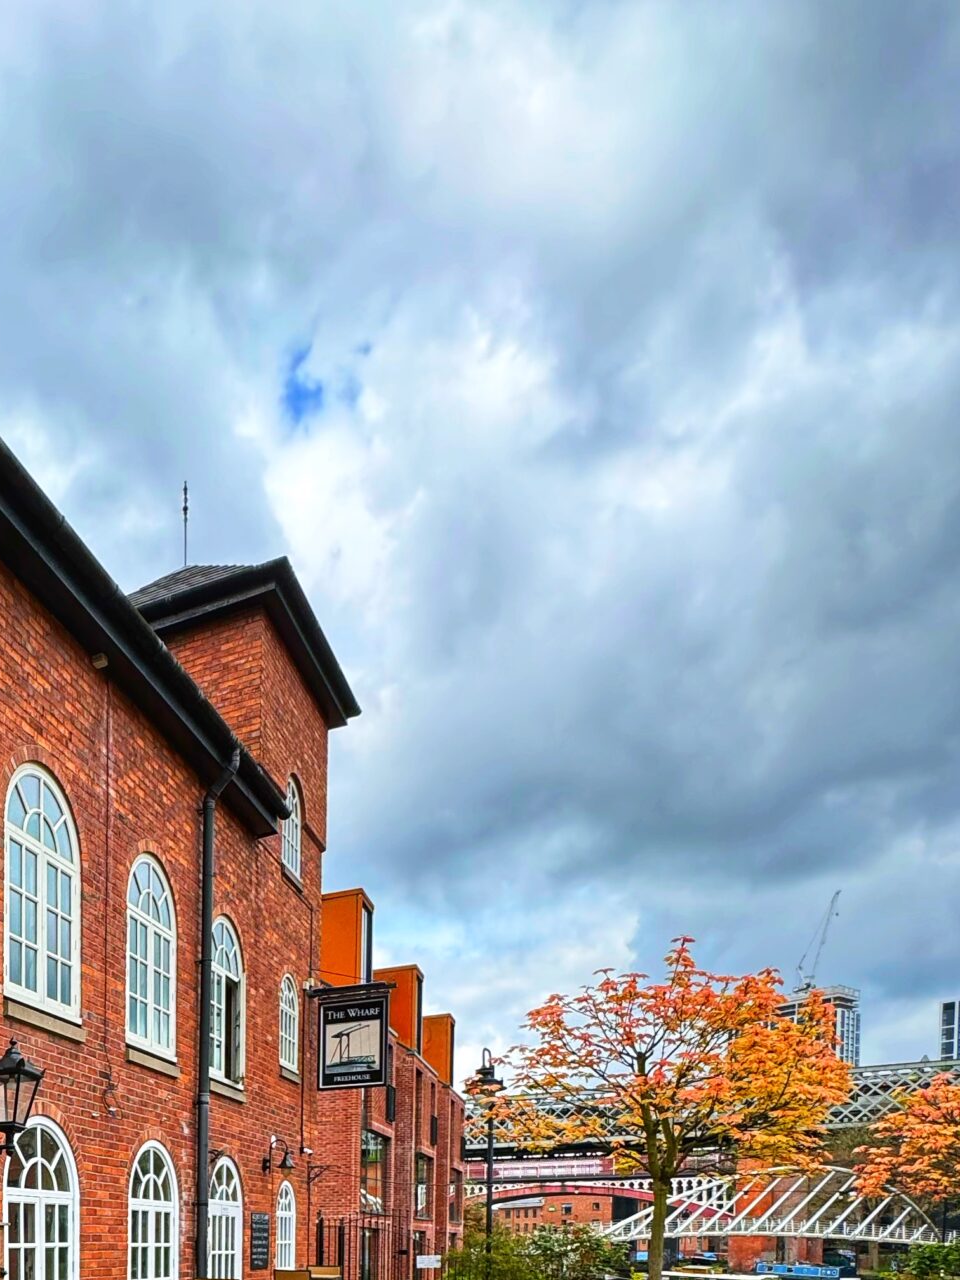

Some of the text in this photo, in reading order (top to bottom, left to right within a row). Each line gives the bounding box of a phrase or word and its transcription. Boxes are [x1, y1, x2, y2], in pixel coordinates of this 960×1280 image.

[326, 1007, 381, 1020] THE WHARF
[333, 1074, 371, 1082] FREEHOUSE
